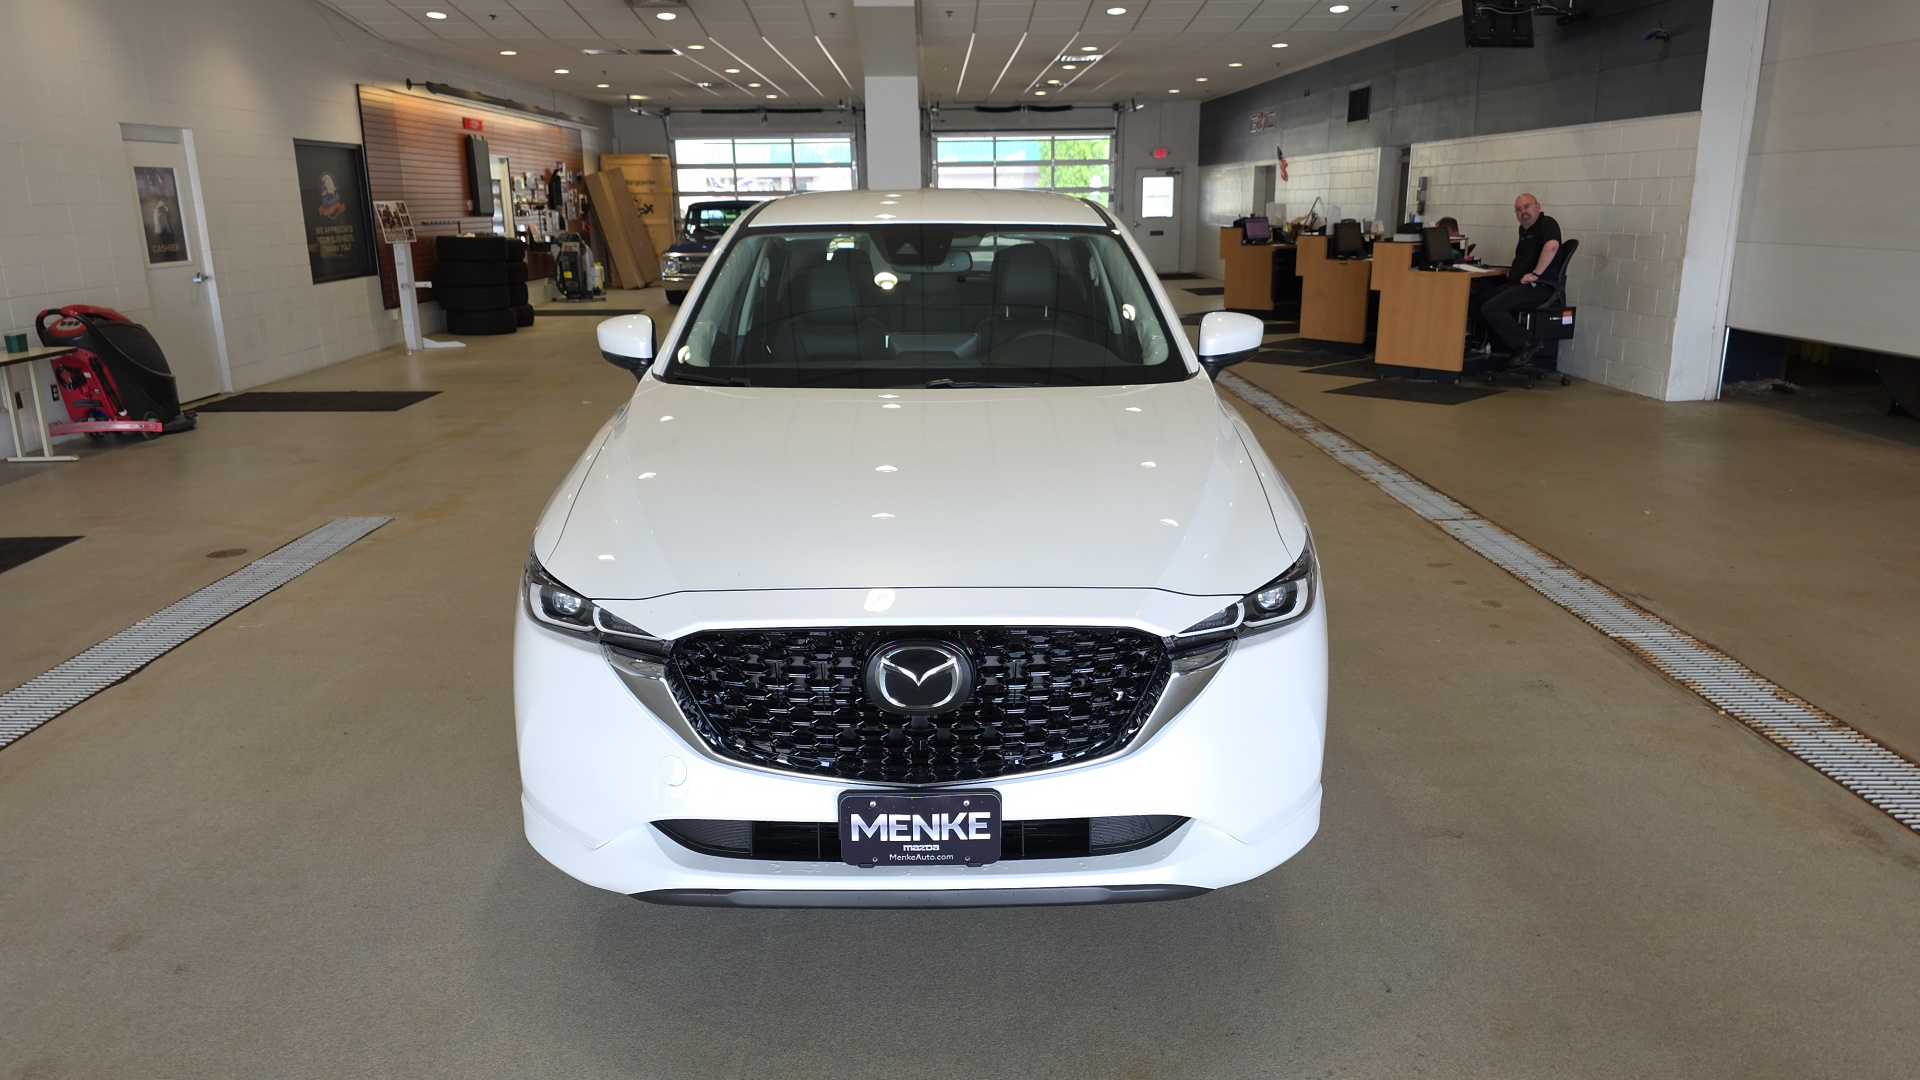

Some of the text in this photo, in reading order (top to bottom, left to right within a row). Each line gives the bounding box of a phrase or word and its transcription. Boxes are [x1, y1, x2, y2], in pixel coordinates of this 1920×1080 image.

[324, 225, 354, 234] APPRECIATE
[316, 236, 330, 244] YOUR
[152, 243, 180, 253] CASHIER
[323, 244, 339, 253] THANK
[850, 811, 991, 842] MENKE
[889, 853, 954, 861] MenkeAuto.com
